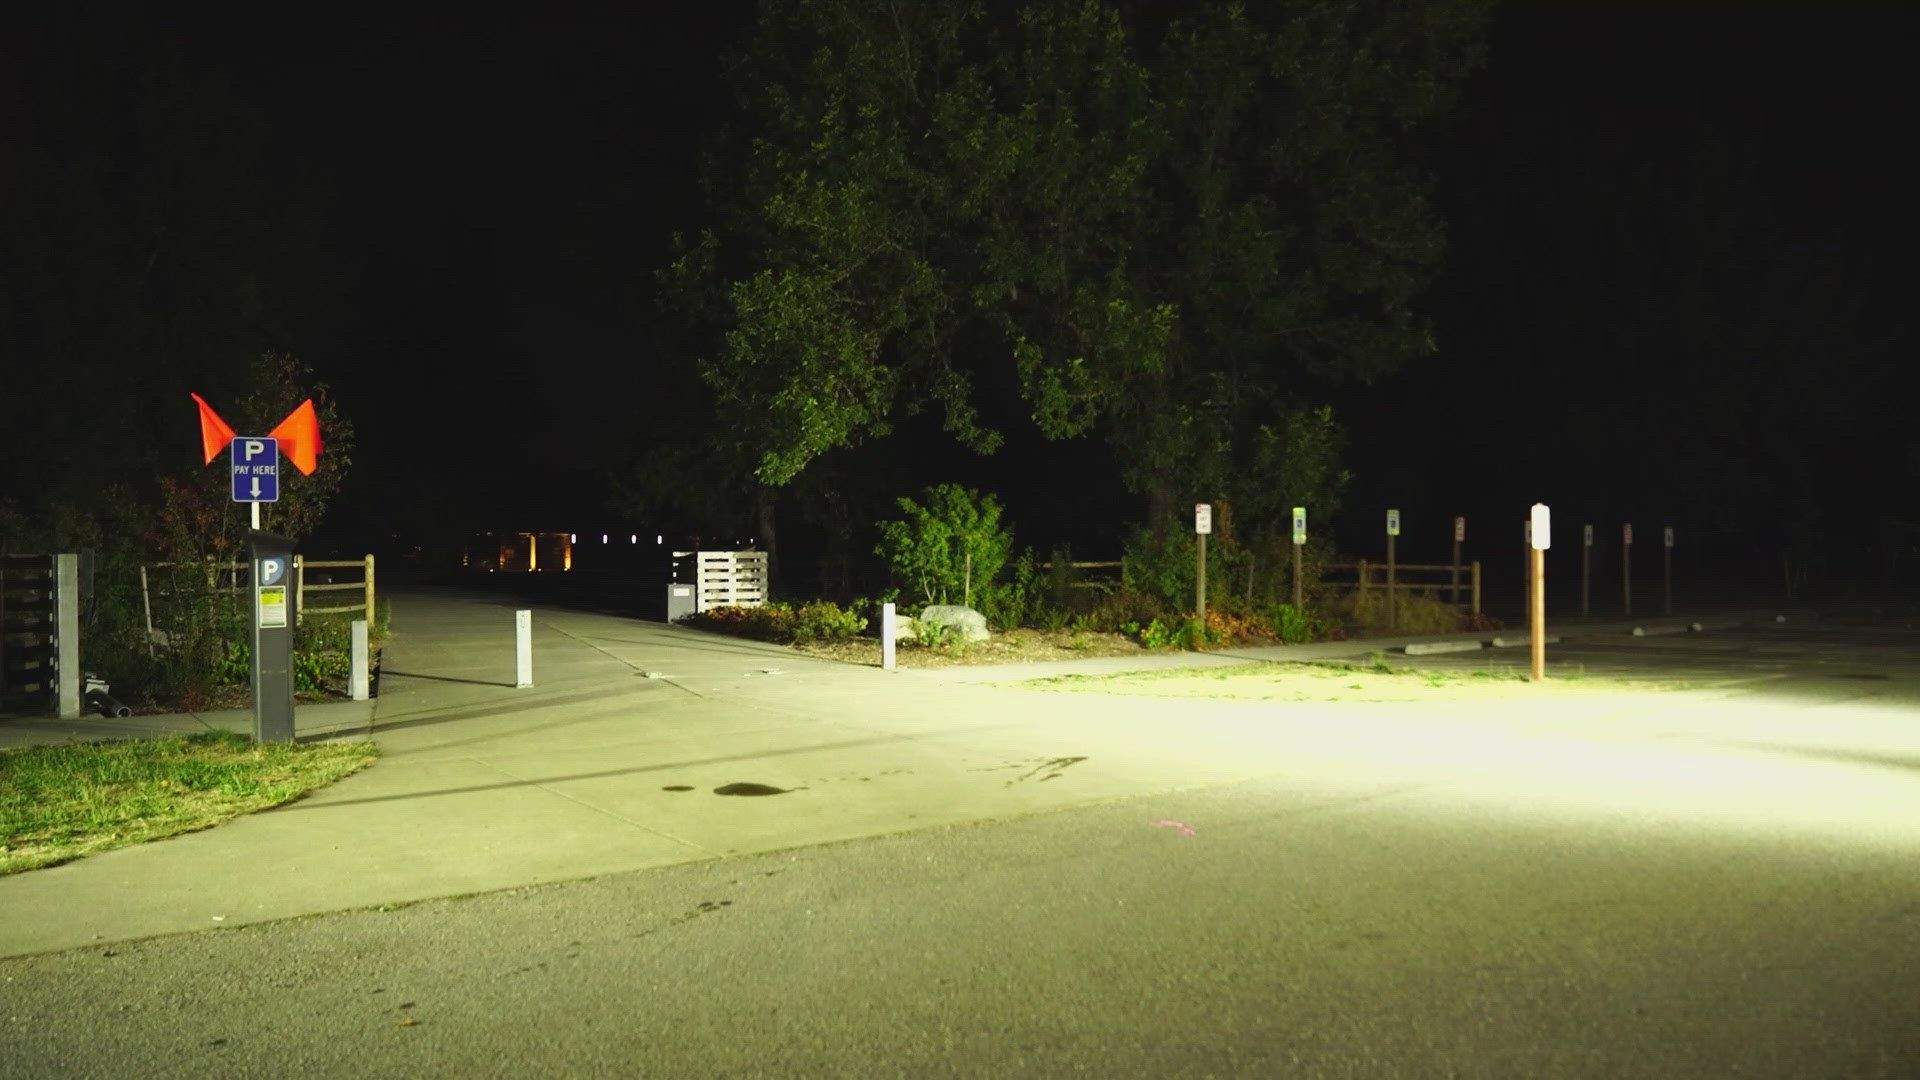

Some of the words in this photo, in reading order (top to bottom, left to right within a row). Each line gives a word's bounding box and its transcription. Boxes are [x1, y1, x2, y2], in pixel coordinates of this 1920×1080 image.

[246, 441, 264, 461] P
[234, 465, 249, 475] PAY
[253, 465, 276, 475] HERE
[264, 560, 279, 581] P
